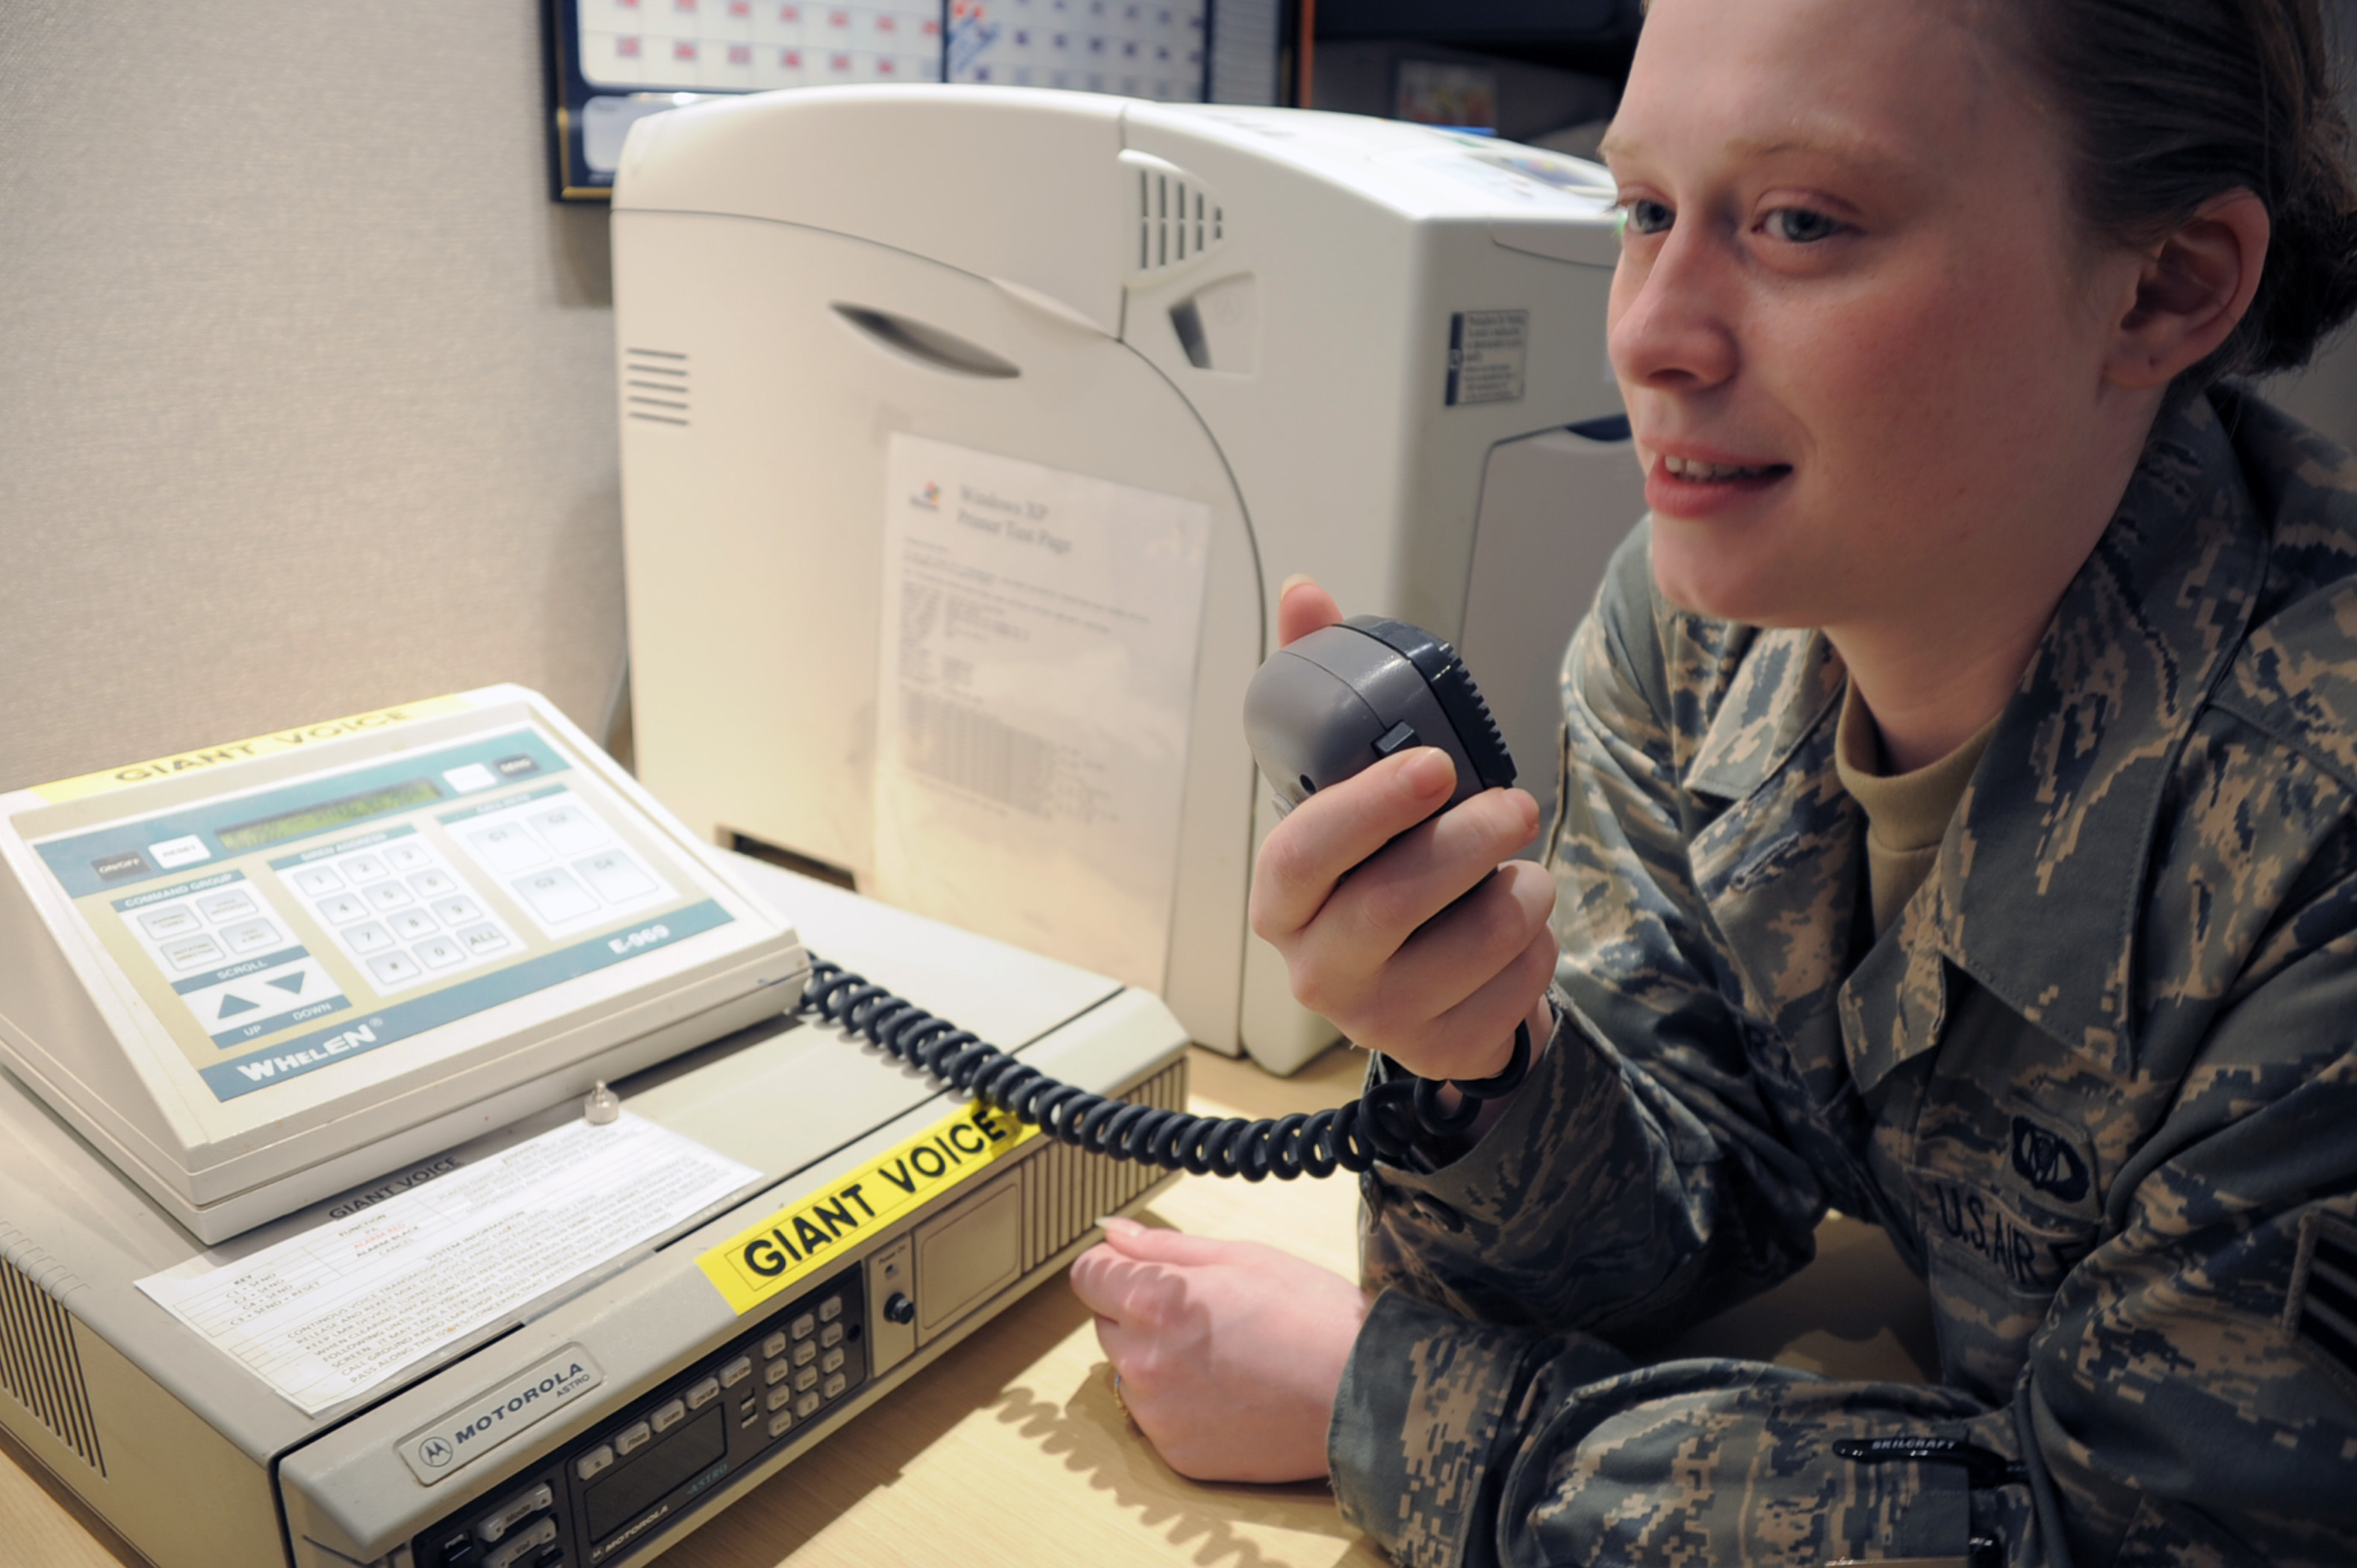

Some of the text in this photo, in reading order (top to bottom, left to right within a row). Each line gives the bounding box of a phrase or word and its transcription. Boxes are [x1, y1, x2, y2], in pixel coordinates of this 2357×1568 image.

[114, 709, 410, 783] GIANT VOICE
[487, 829, 508, 841] C1
[99, 858, 139, 873] ON/OFF
[358, 862, 369, 872] 2
[401, 850, 413, 859] 3
[125, 871, 232, 906] COMMAND GROUP
[313, 874, 323, 884] 1
[426, 876, 438, 886] 6
[338, 902, 349, 912] 4
[382, 889, 394, 899] 5
[450, 904, 462, 913] 9
[361, 930, 371, 941] 7
[407, 918, 419, 927] 8
[432, 946, 445, 956] 0
[469, 931, 495, 945] ALL
[609, 924, 668, 953] E-969
[217, 960, 267, 979] SCROLL
[243, 1003, 331, 1036] UP DOWN
[237, 1025, 374, 1079] WHELEN
[329, 1186, 394, 1219] GIANT
[397, 1157, 461, 1187] VOICE
[743, 1184, 875, 1277] GIANT
[878, 1110, 1005, 1194] VOICE
[225, 1272, 276, 1298] C1 SEND
[233, 1274, 252, 1285] KEY
[233, 1278, 285, 1304] C2 SEND
[229, 1281, 319, 1325] C3 SEND RESET
[241, 1284, 293, 1310] C4 SEND
[296, 1322, 337, 1344] RELEASE
[341, 1310, 362, 1323] AND
[419, 1272, 438, 1284] FOR
[348, 1292, 378, 1309] VOICE
[388, 1325, 411, 1339] MAY
[413, 1313, 436, 1326] TAKE
[447, 1298, 469, 1310] FEW
[469, 1283, 499, 1298] TIMES
[497, 1275, 513, 1284] TO
[305, 1336, 329, 1350] KEEP
[332, 1325, 354, 1337] LMR
[355, 1304, 396, 1326] DEVICES
[397, 1285, 435, 1304] TURNED
[313, 1338, 347, 1356] WHEN
[348, 1315, 397, 1339] CLEARING
[398, 1303, 417, 1315] ANY
[420, 1284, 459, 1304] ACTIONS
[460, 1274, 476, 1284] ON
[323, 1331, 384, 1362] FOLLOWING
[384, 1316, 414, 1331] UNTIL
[414, 1303, 437, 1316] YOU
[436, 1282, 478, 1305] VISUALLY
[479, 1273, 497, 1284] SEE
[497, 1263, 515, 1273] THE
[341, 1360, 367, 1376] CALL
[367, 1337, 412, 1360] GROUND
[413, 1320, 444, 1337] RADIO
[445, 1309, 466, 1322] LMR
[467, 1295, 492, 1310] SHOP
[350, 1366, 377, 1383] PASS
[378, 1347, 413, 1367] ALONG
[413, 1336, 433, 1347] THE
[519, 1278, 543, 1292] THAT
[556, 1374, 590, 1397] ASTRO
[455, 1363, 583, 1444] MOTOROLA
[1872, 1439, 1957, 1450] SKILCRAFT
[688, 1463, 727, 1495] ASTRO
[605, 1505, 668, 1552] MOTOROLA
